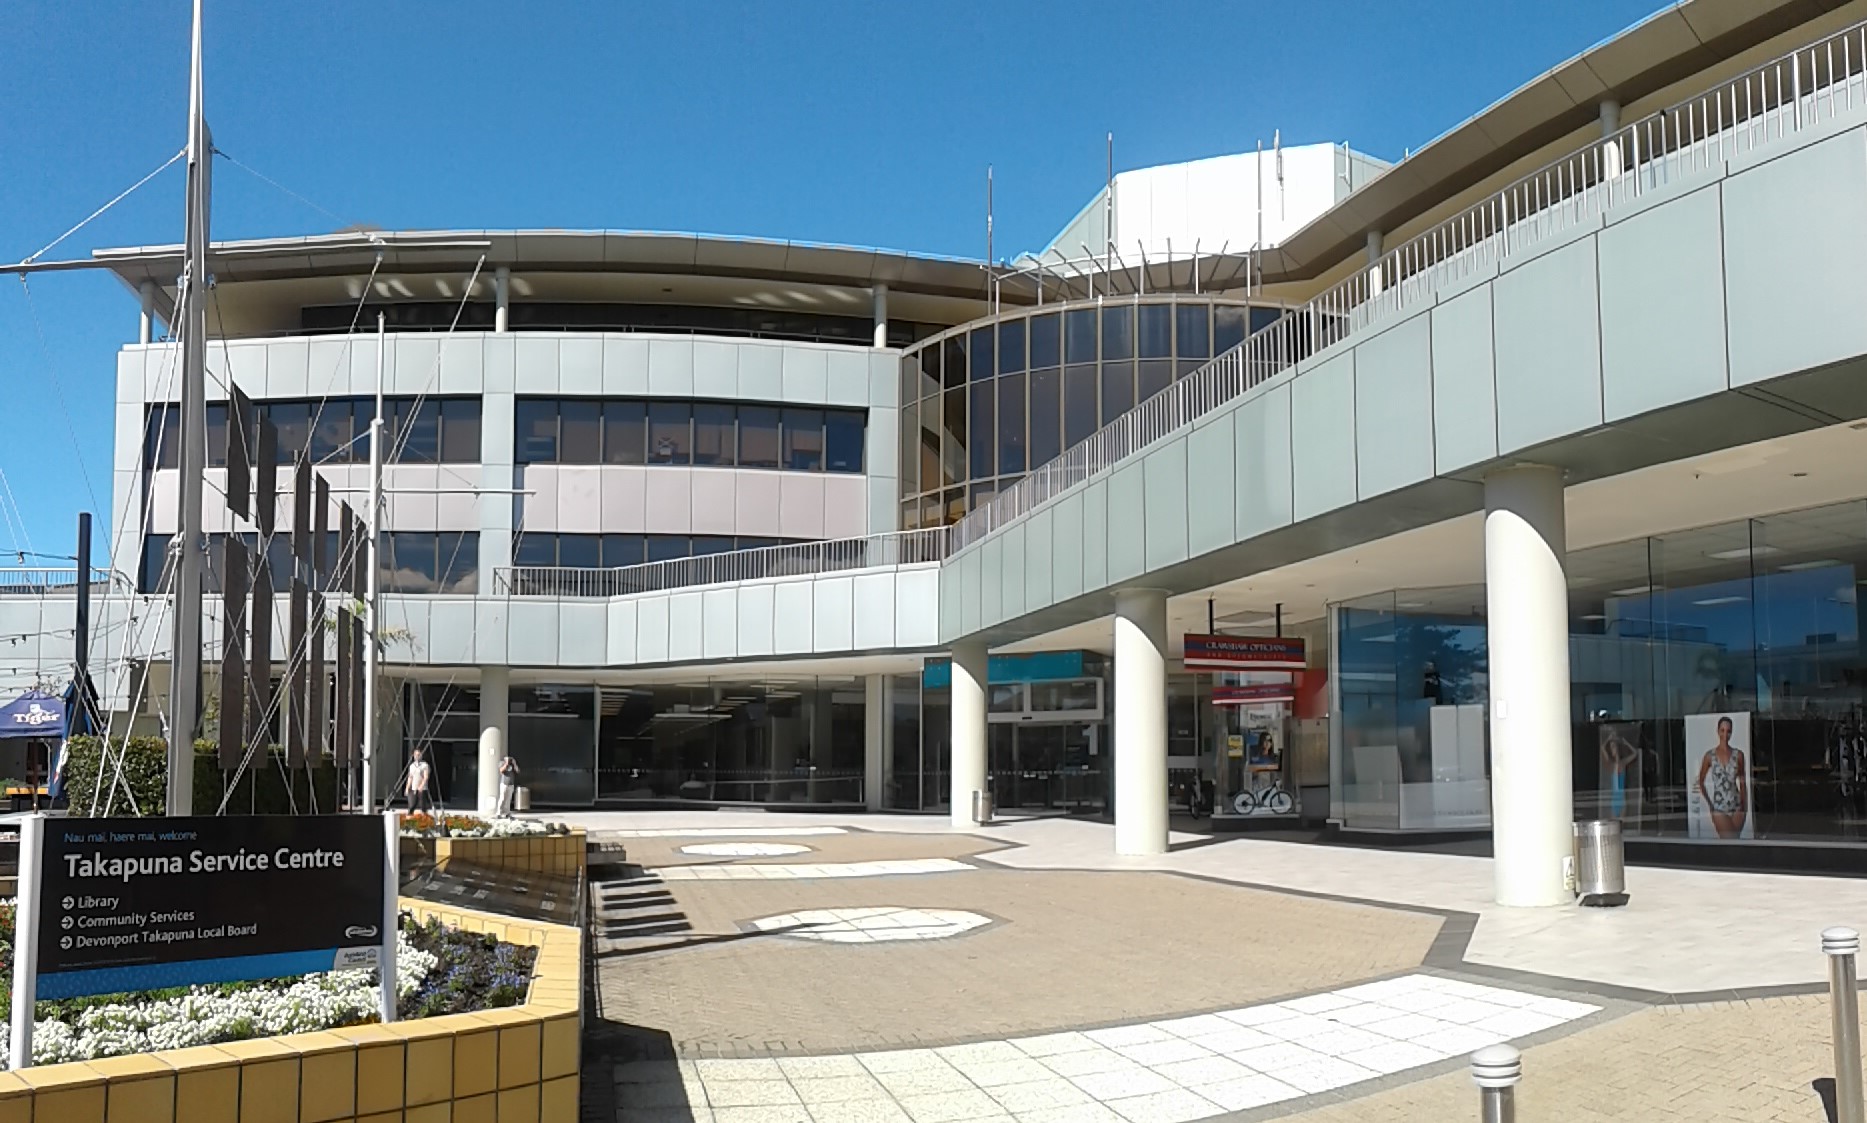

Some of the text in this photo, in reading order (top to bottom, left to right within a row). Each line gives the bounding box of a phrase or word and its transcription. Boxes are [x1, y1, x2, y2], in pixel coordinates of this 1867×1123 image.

[1249, 643, 1286, 652] OPTICIANS
[13, 712, 60, 725] Tiger
[1082, 723, 1098, 755] 1
[64, 832, 84, 842] Nau
[109, 832, 135, 842] haere
[160, 829, 197, 840] welcome
[64, 847, 345, 882] Takapuna Service Centre
[78, 896, 119, 910] Library
[78, 910, 195, 928] Community Services
[76, 923, 257, 949] Devonport Takapuna Local Board
